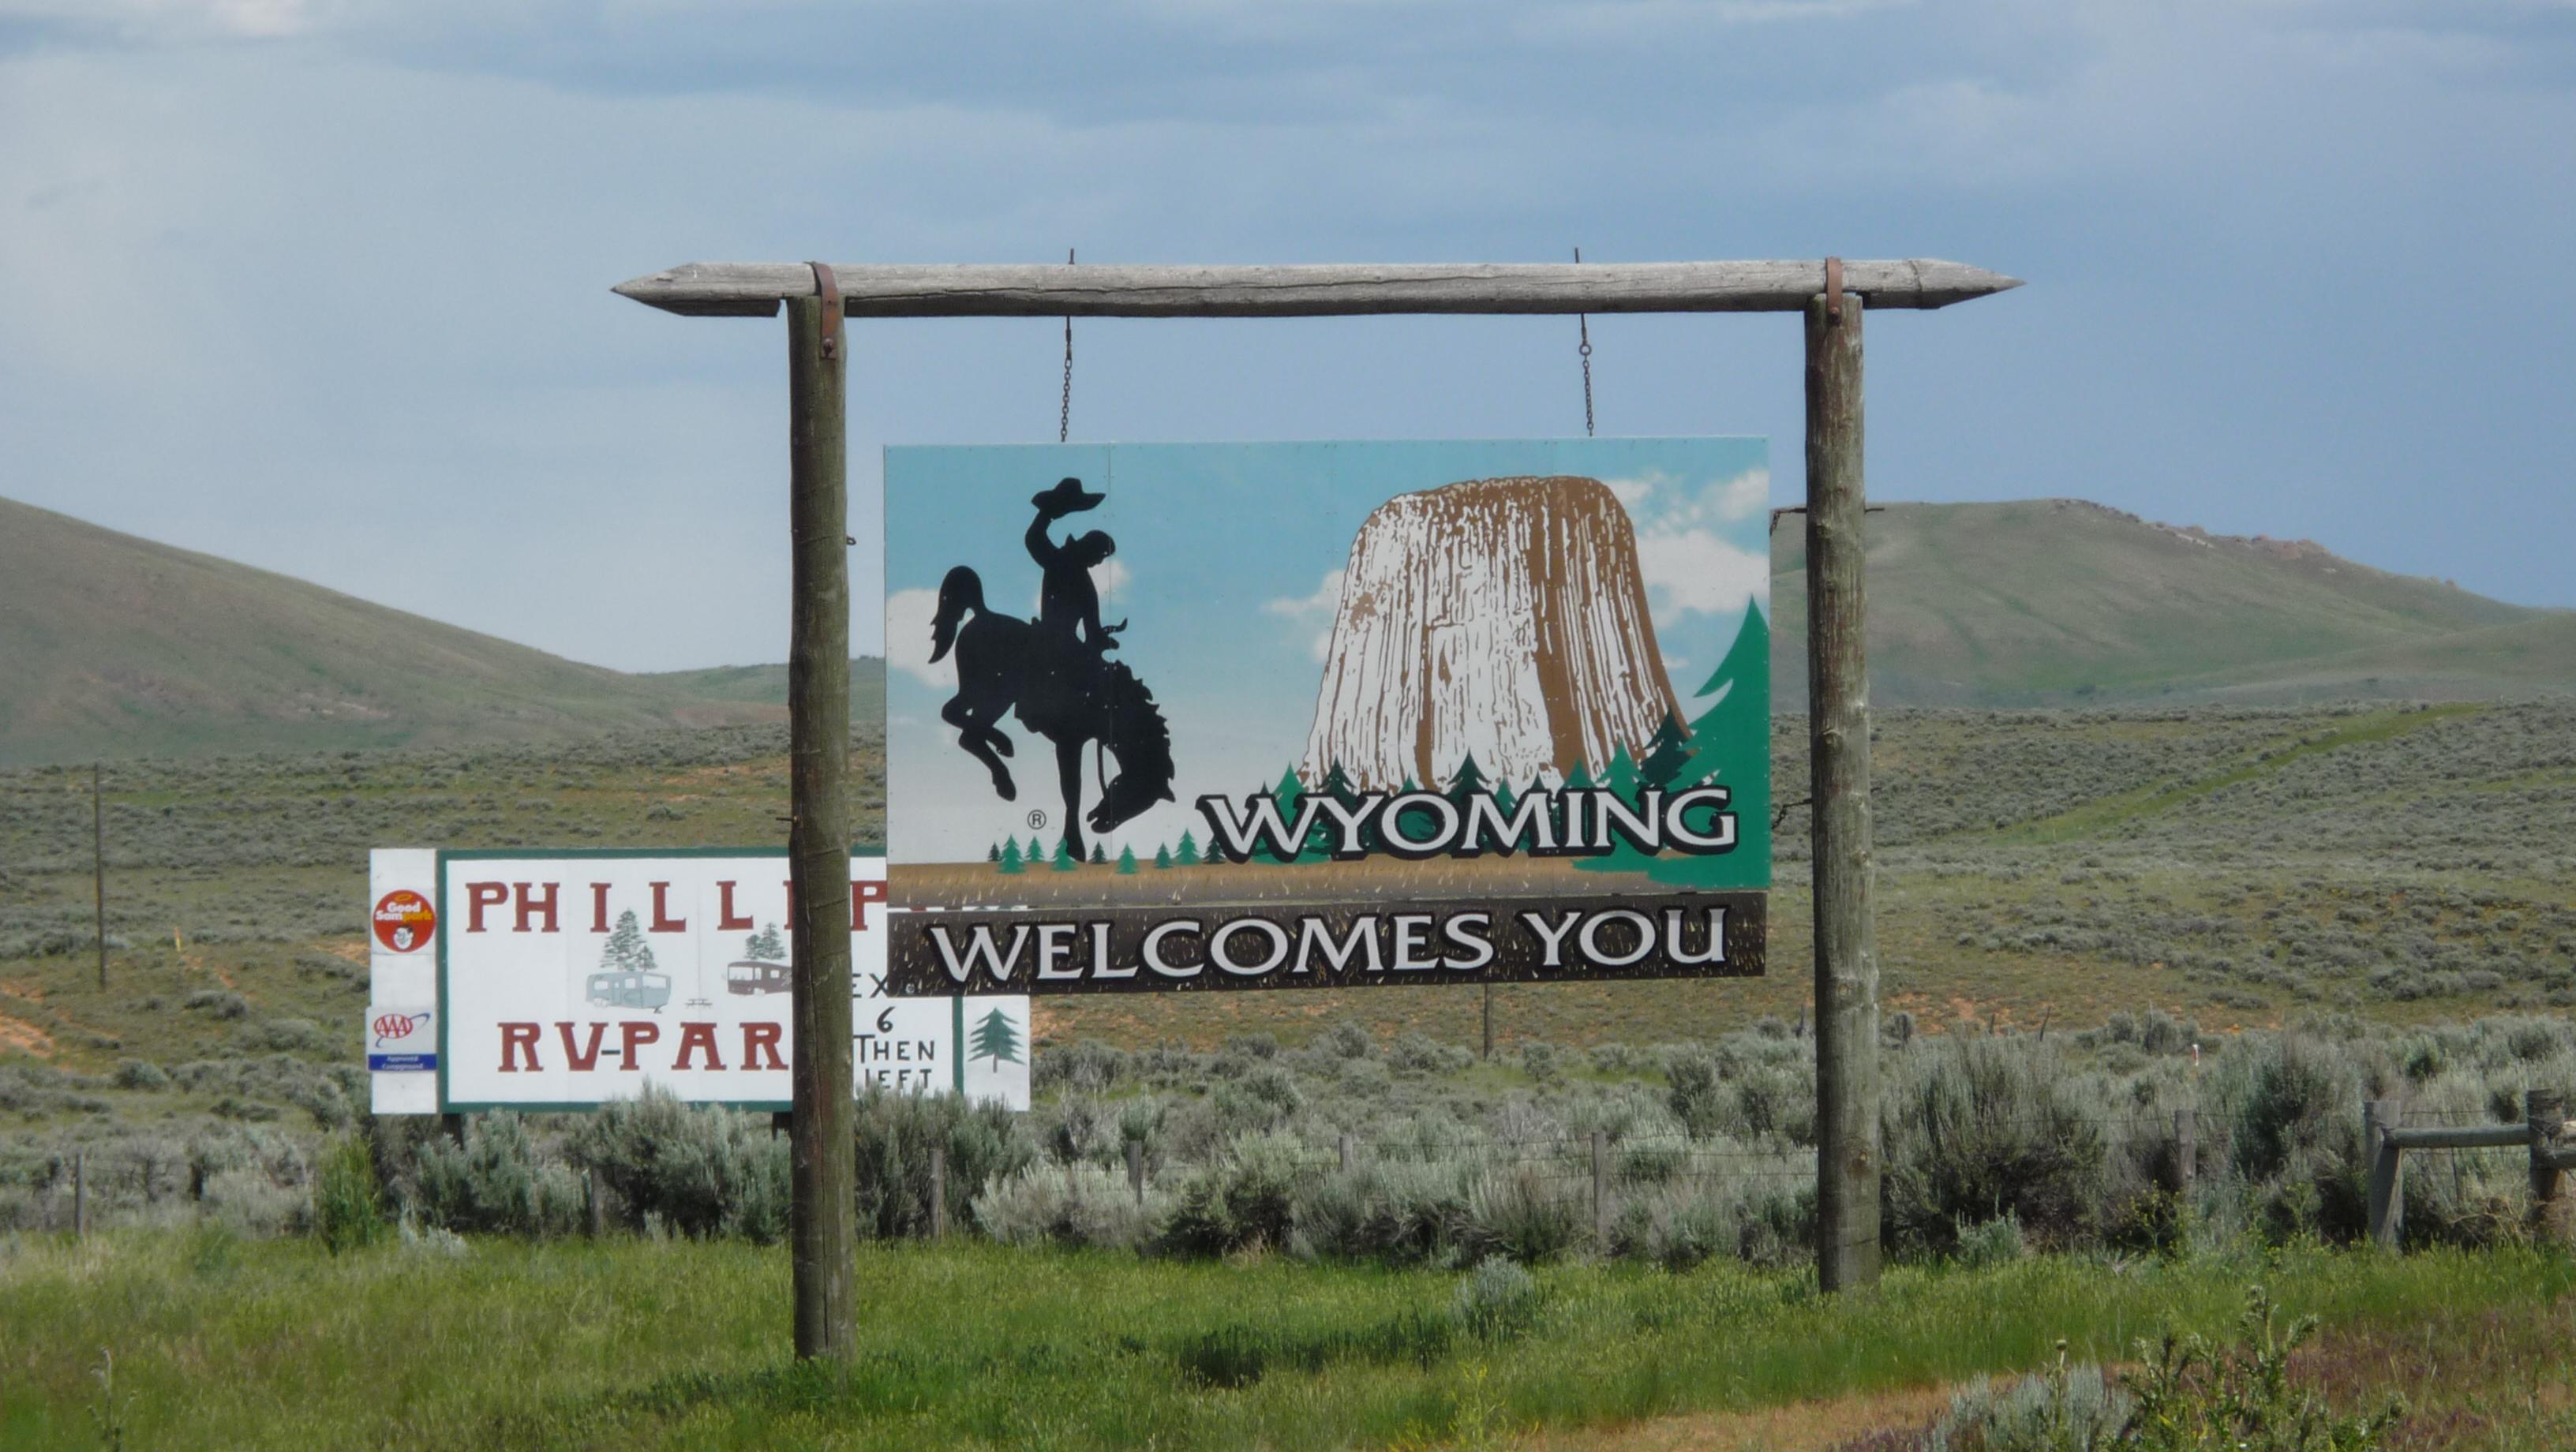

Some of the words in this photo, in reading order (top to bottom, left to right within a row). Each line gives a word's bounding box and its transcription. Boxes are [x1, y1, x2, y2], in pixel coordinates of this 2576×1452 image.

[1197, 788, 1737, 862] WYOMING
[387, 900, 421, 913] Good
[925, 910, 1496, 984] WELCOMES
[1517, 907, 1730, 967] YOU
[378, 1014, 409, 1038] AAA
[876, 1005, 896, 1034] 6
[852, 1034, 934, 1064] THEN
